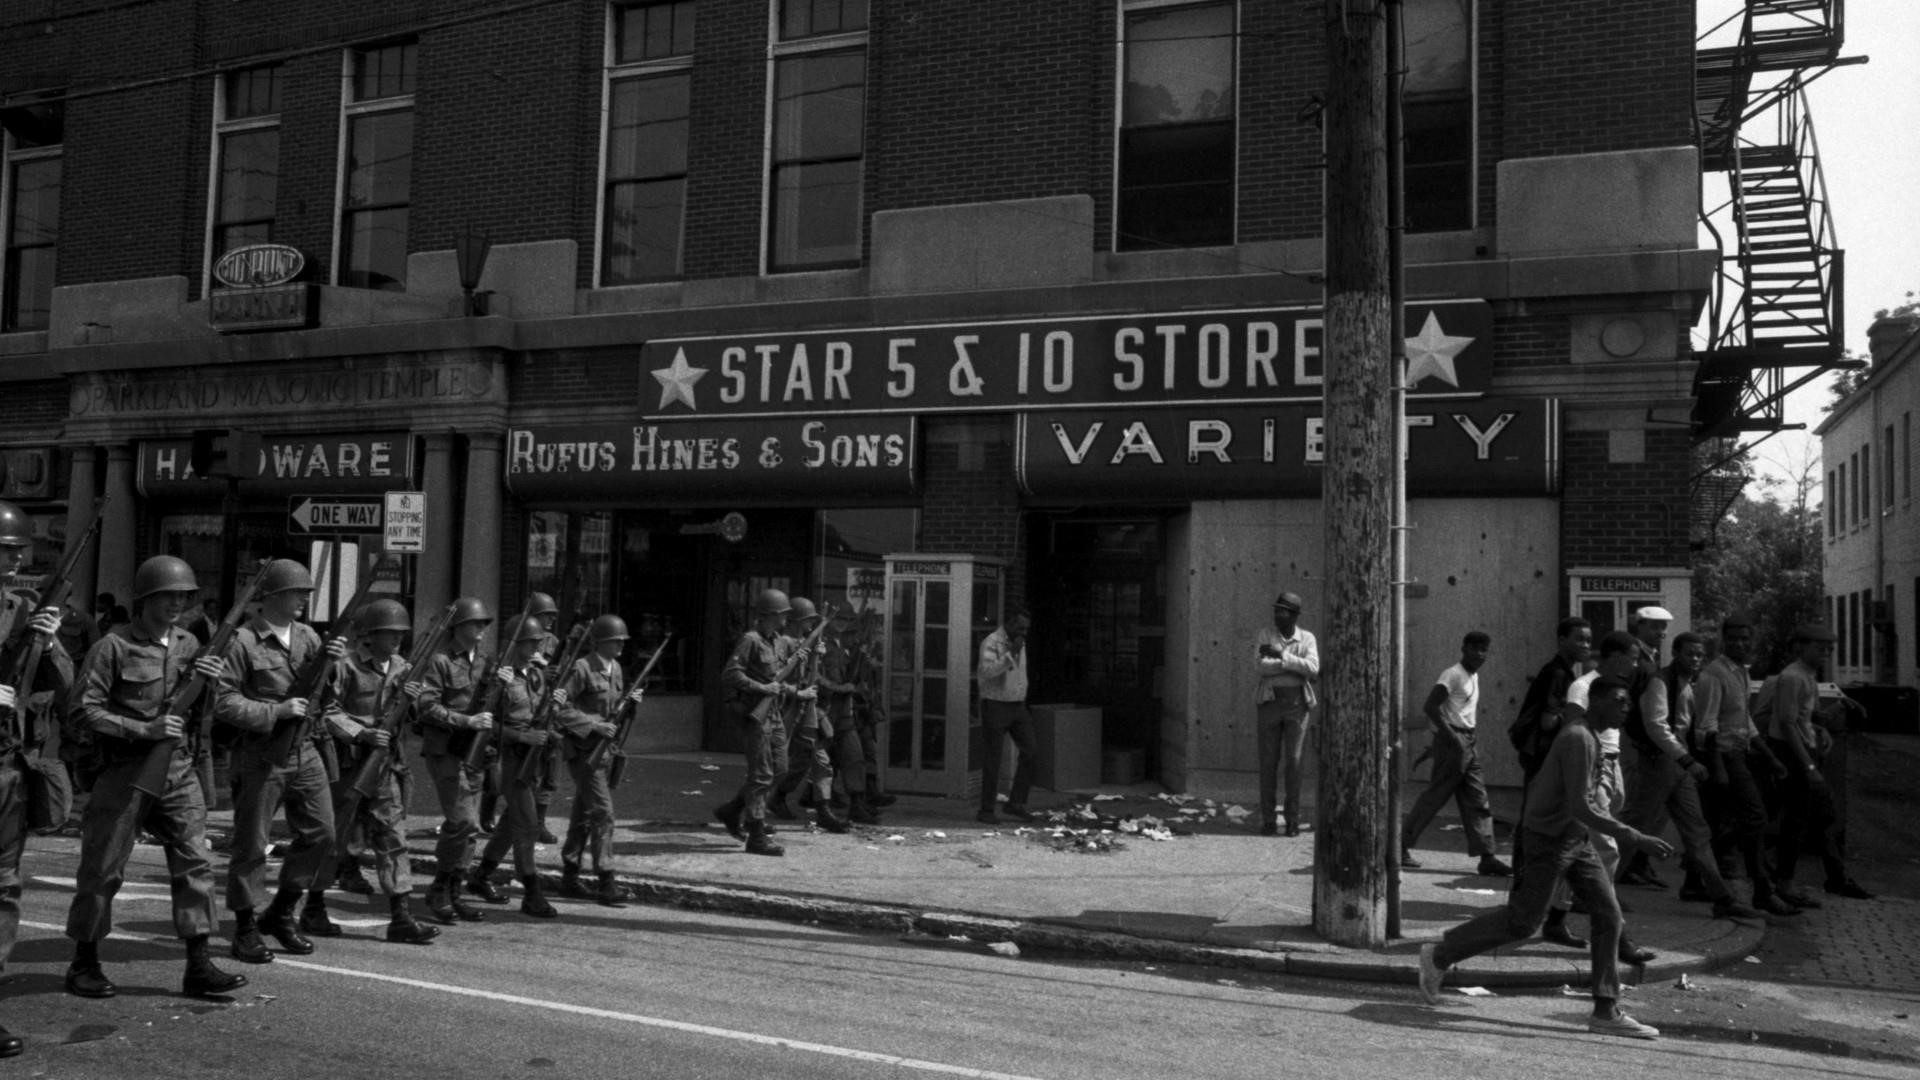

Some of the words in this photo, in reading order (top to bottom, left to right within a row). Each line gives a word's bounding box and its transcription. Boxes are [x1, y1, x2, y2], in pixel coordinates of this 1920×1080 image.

[720, 341, 853, 402] STAR
[887, 338, 916, 398] 5
[949, 335, 984, 396] &
[1018, 330, 1074, 394] 10
[1113, 318, 1323, 391] STORE
[91, 382, 219, 413] PARKLAND
[365, 367, 464, 401] TEMPLE
[156, 442, 391, 480] HWARE
[758, 437, 784, 469] &
[400, 497, 411, 509] NO
[311, 506, 340, 525] ONE
[347, 506, 376, 525] WAY
[388, 512, 423, 523] STOPPING
[388, 526, 403, 537] ANY
[406, 526, 422, 537] TIME
[1584, 578, 1657, 591] TELEPHONE
